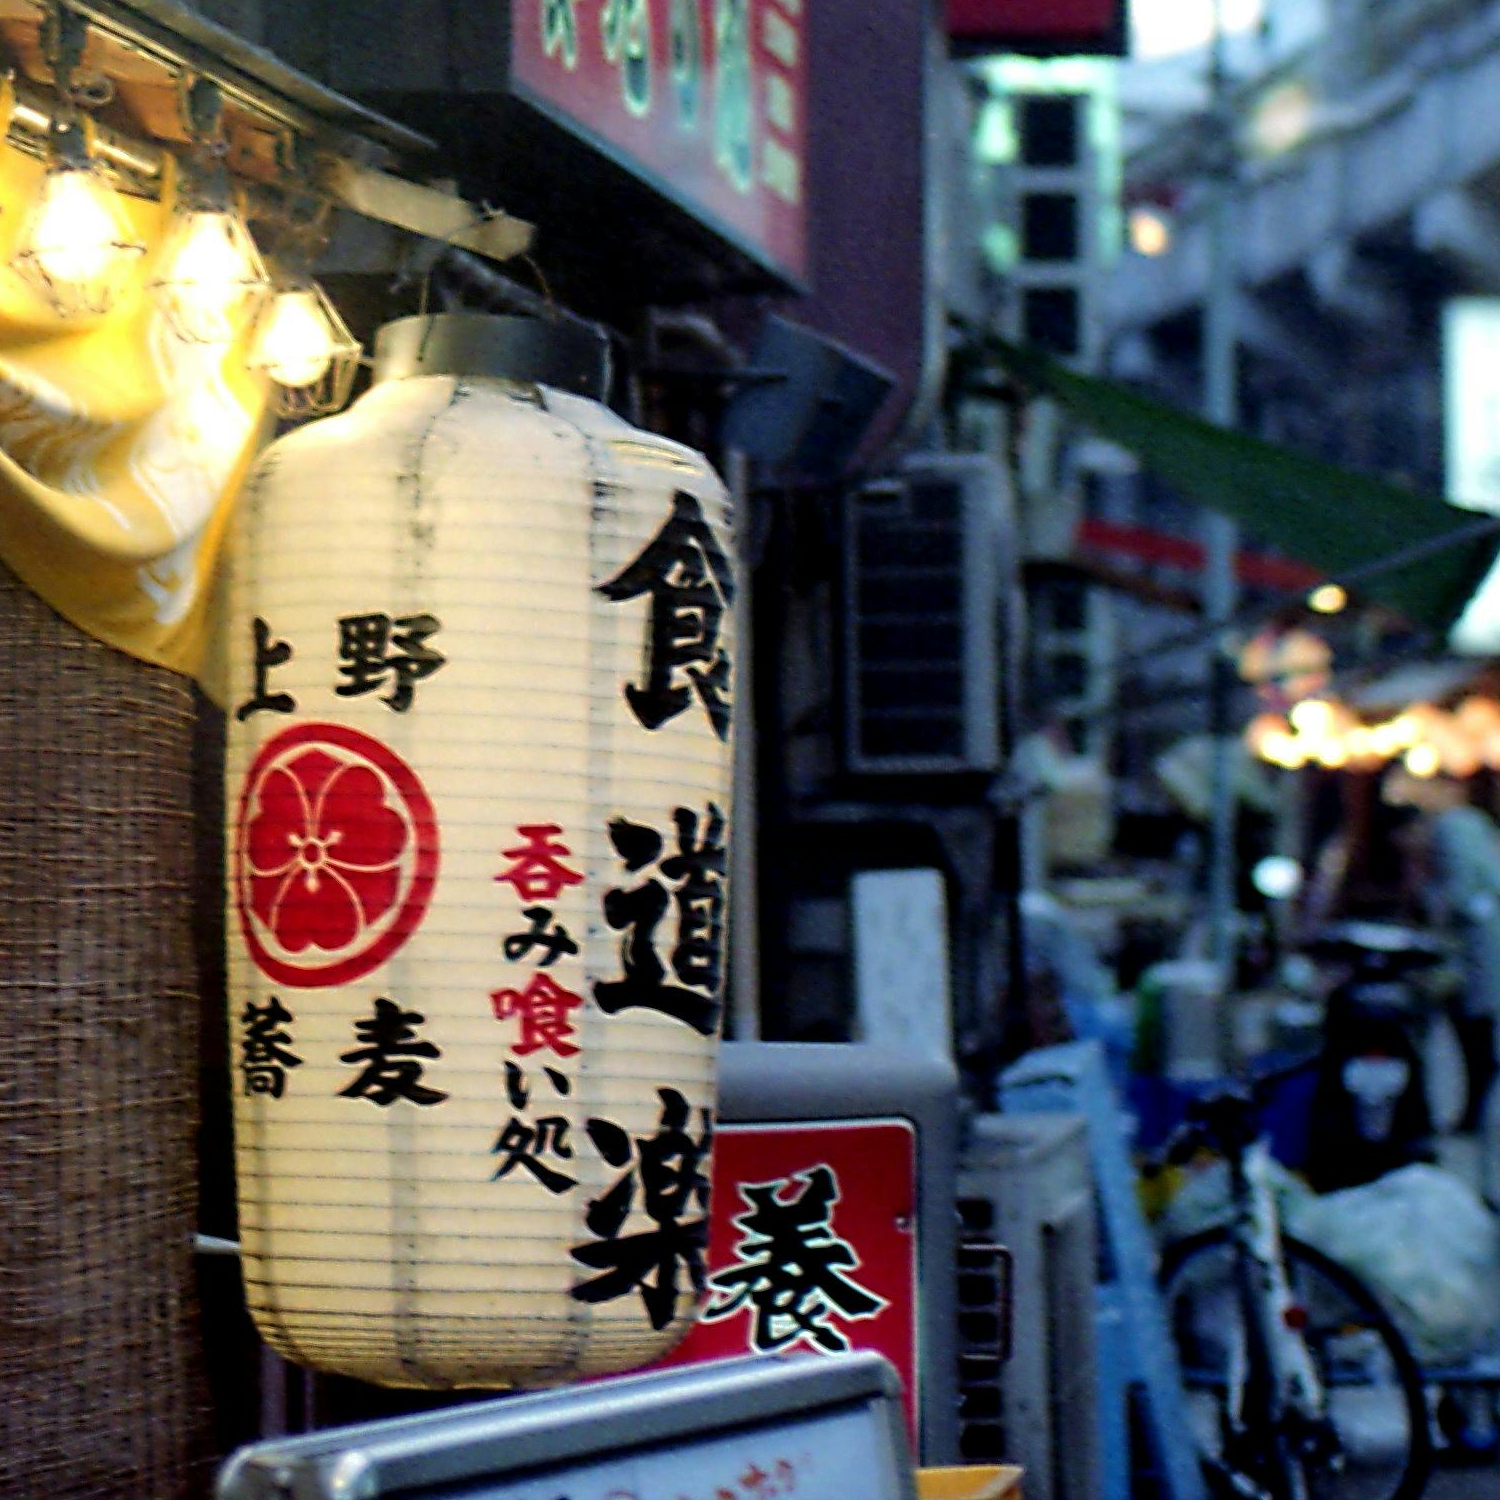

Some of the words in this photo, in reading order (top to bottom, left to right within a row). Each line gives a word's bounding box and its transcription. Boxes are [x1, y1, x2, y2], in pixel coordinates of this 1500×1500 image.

[237, 612, 447, 722] 上野
[490, 823, 585, 1194] 呑み喰い処
[570, 488, 734, 1330] 食道楽
[239, 997, 449, 1107] 蕎麦
